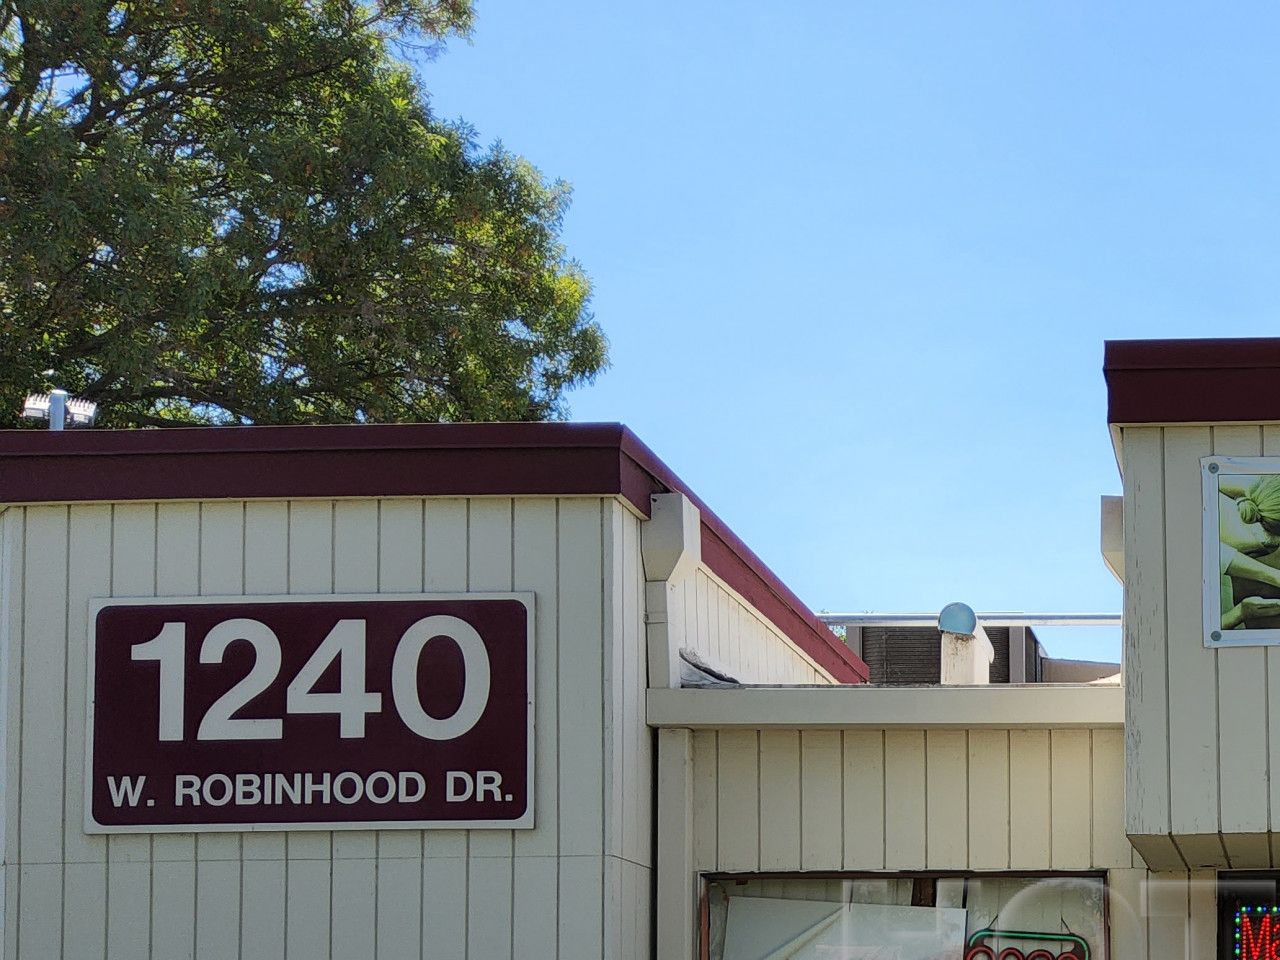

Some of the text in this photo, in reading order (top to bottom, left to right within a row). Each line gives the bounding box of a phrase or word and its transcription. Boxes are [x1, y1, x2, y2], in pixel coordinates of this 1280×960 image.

[130, 614, 491, 742] 1240
[107, 770, 514, 807] W. ROBINHOOD DR.
